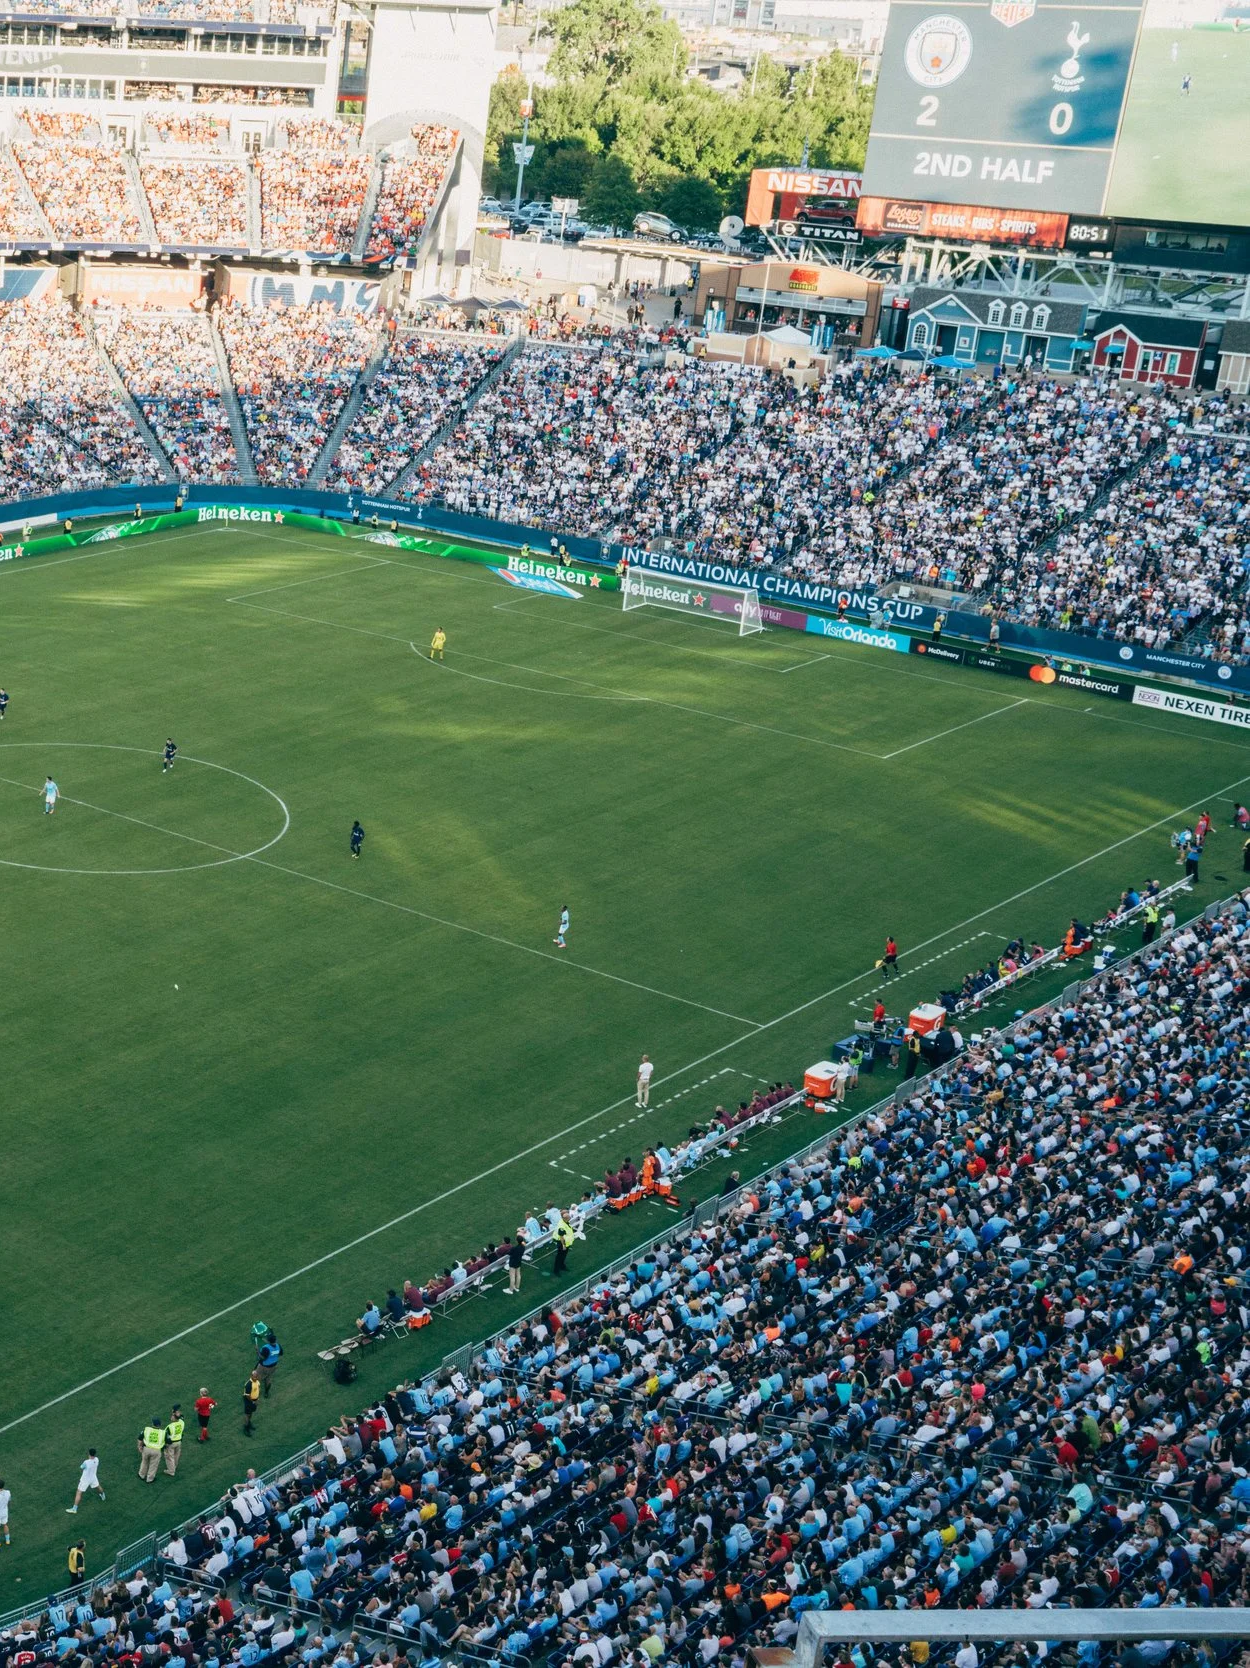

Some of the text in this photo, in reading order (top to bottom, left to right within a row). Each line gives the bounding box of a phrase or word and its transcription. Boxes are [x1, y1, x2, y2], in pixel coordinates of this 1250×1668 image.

[916, 95, 940, 127] 2
[1049, 102, 1074, 135] 0
[913, 151, 1055, 184] 2ND HALF
[767, 172, 863, 198] NISSAN
[801, 226, 859, 240] TITAN
[931, 213, 1037, 235] STEAKS RIBS SPIRITS
[1069, 225, 1108, 241] 80:51
[91, 273, 194, 294] NISSAN
[197, 506, 272, 523] Heineken
[361, 499, 411, 513] TOTTENHAM HOTSPUR
[508, 556, 587, 586] Heineken
[620, 576, 690, 605] Heineken
[622, 547, 924, 620] INTERNATIONAL CHAMPIONS CUP
[928, 647, 960, 659] McDelivery
[978, 659, 995, 667] UBER
[1146, 654, 1206, 670] MANCHESTER CITY
[1058, 673, 1119, 694] mastercard
[1164, 696, 1215, 716] NEXEN
[206, 1529, 216, 1540] 10
[55, 1609, 64, 1621] 17
